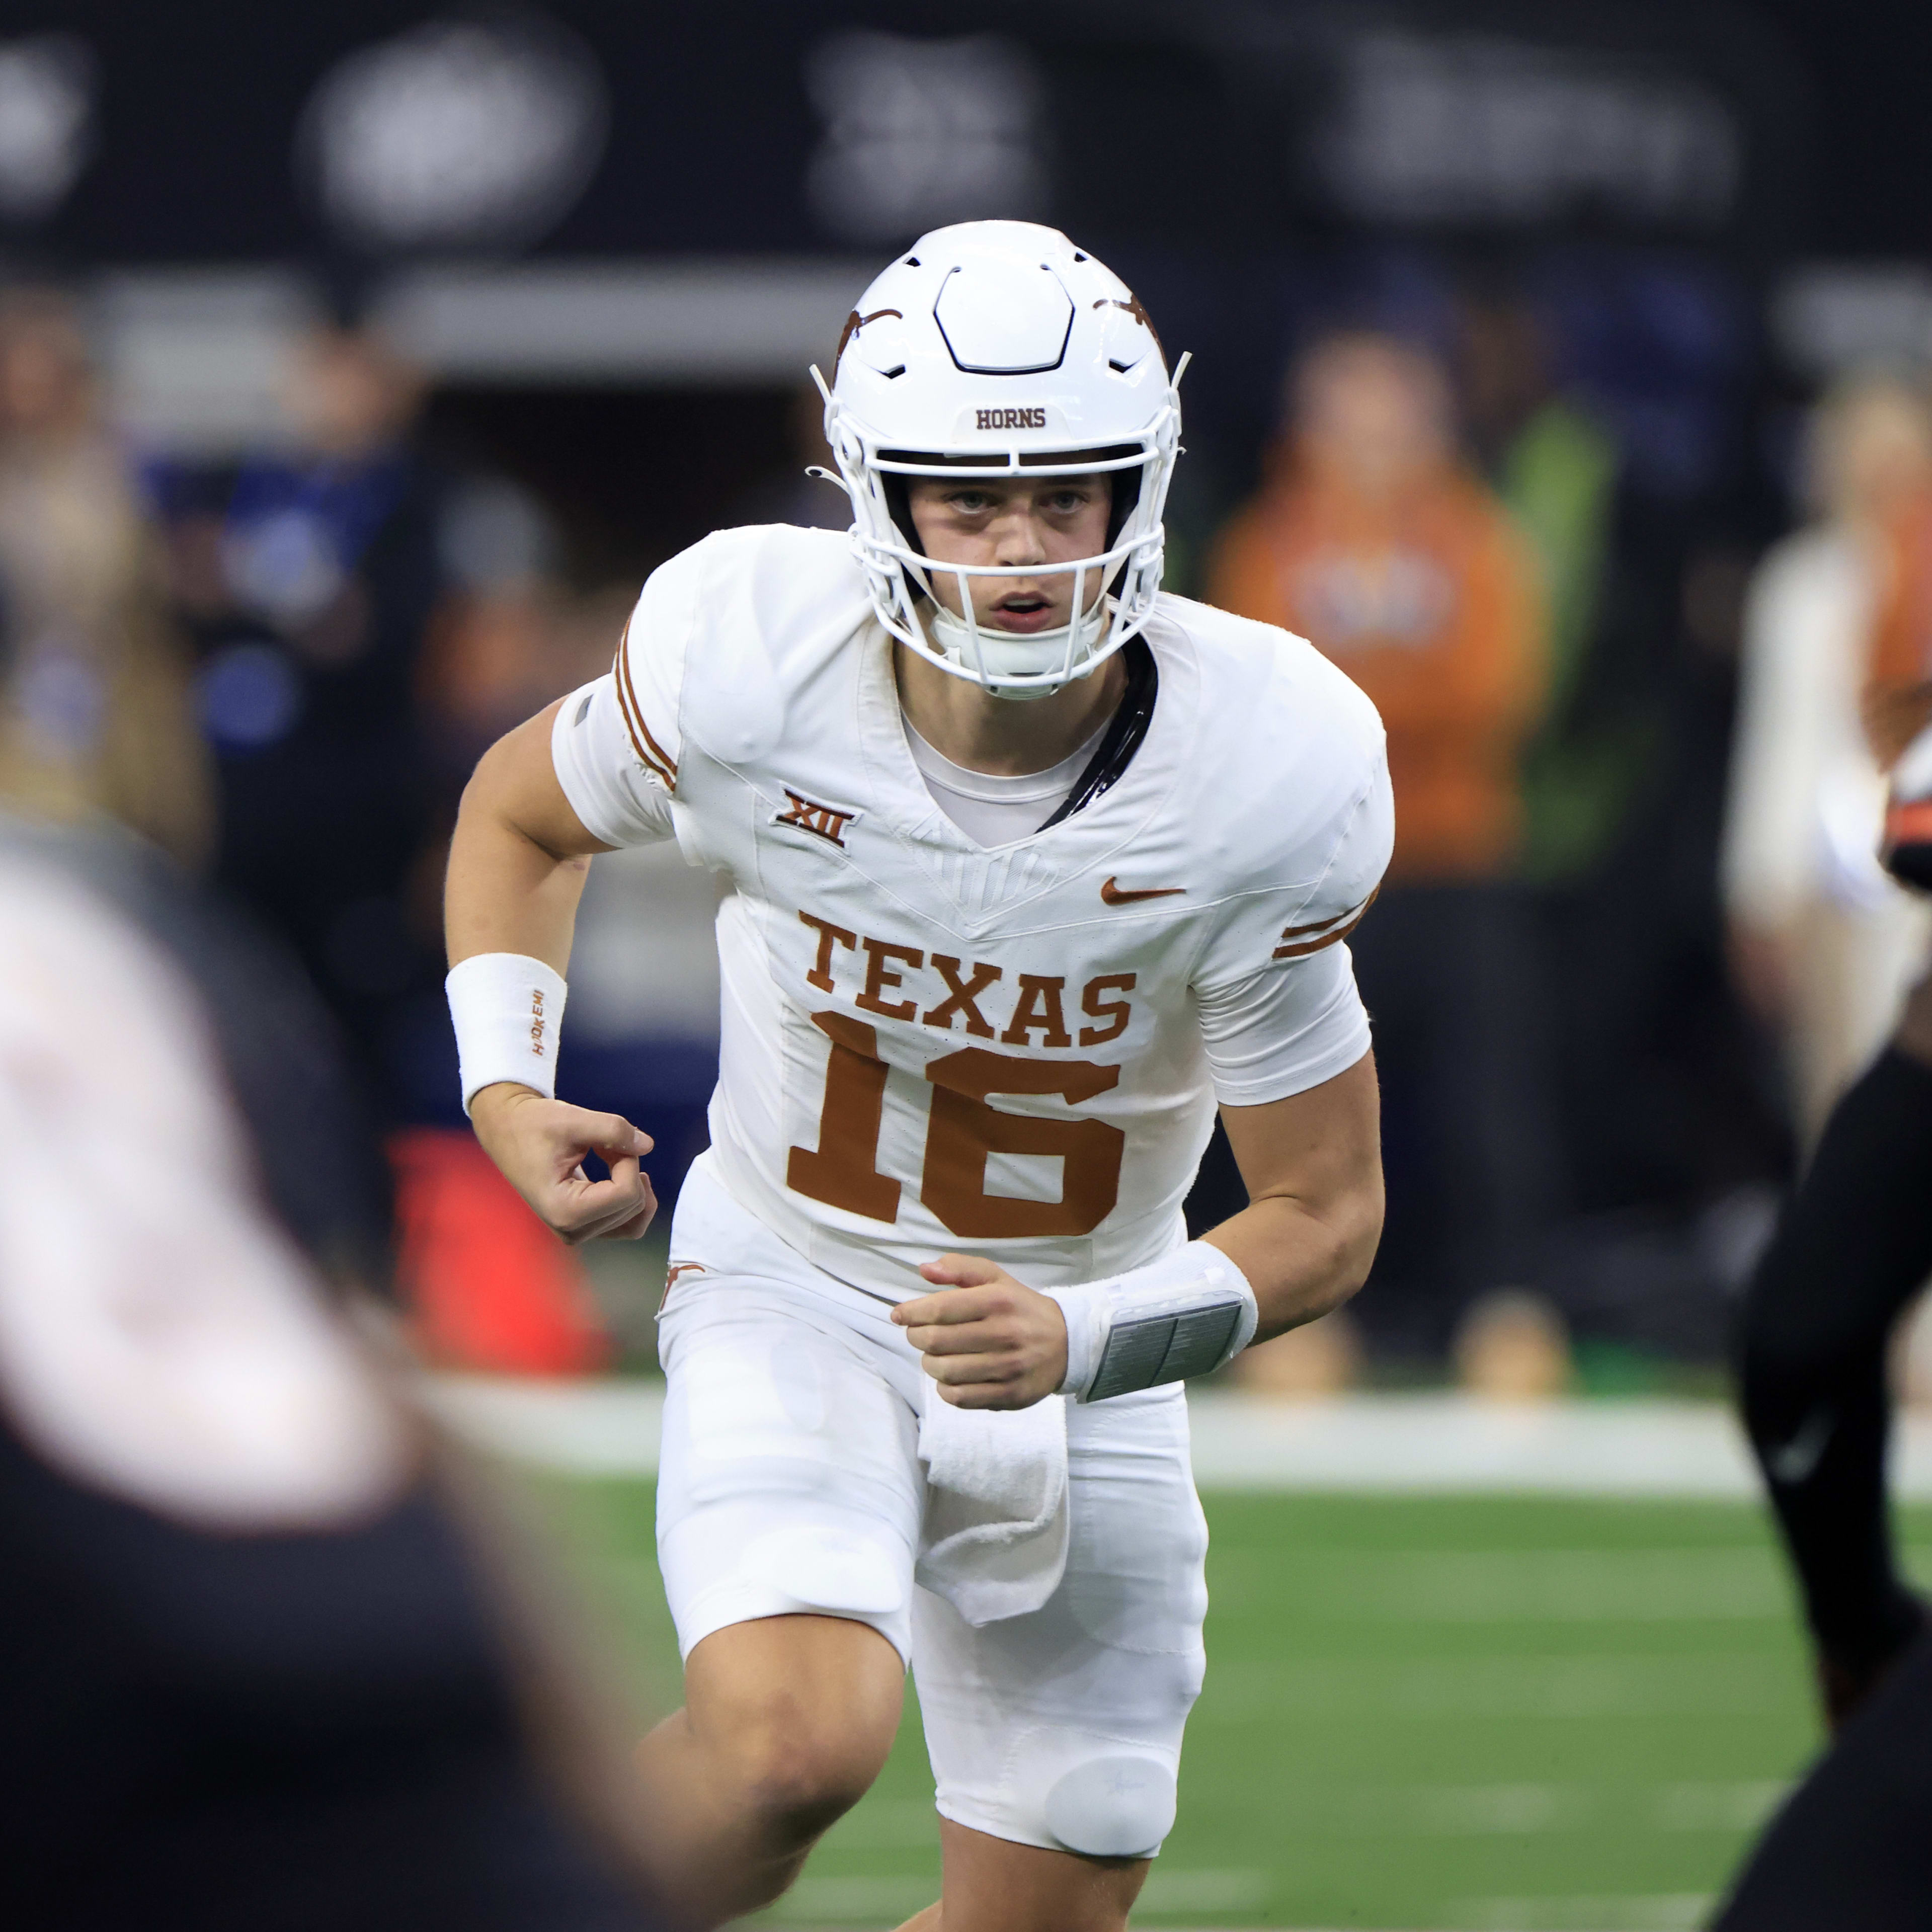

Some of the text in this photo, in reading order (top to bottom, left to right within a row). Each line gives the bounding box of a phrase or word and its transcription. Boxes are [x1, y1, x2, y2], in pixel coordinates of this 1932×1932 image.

[976, 408, 1046, 429] HORNS
[776, 788, 855, 848] XII
[798, 909, 1137, 1048] TEXAS
[787, 1010, 1125, 1238] 16
